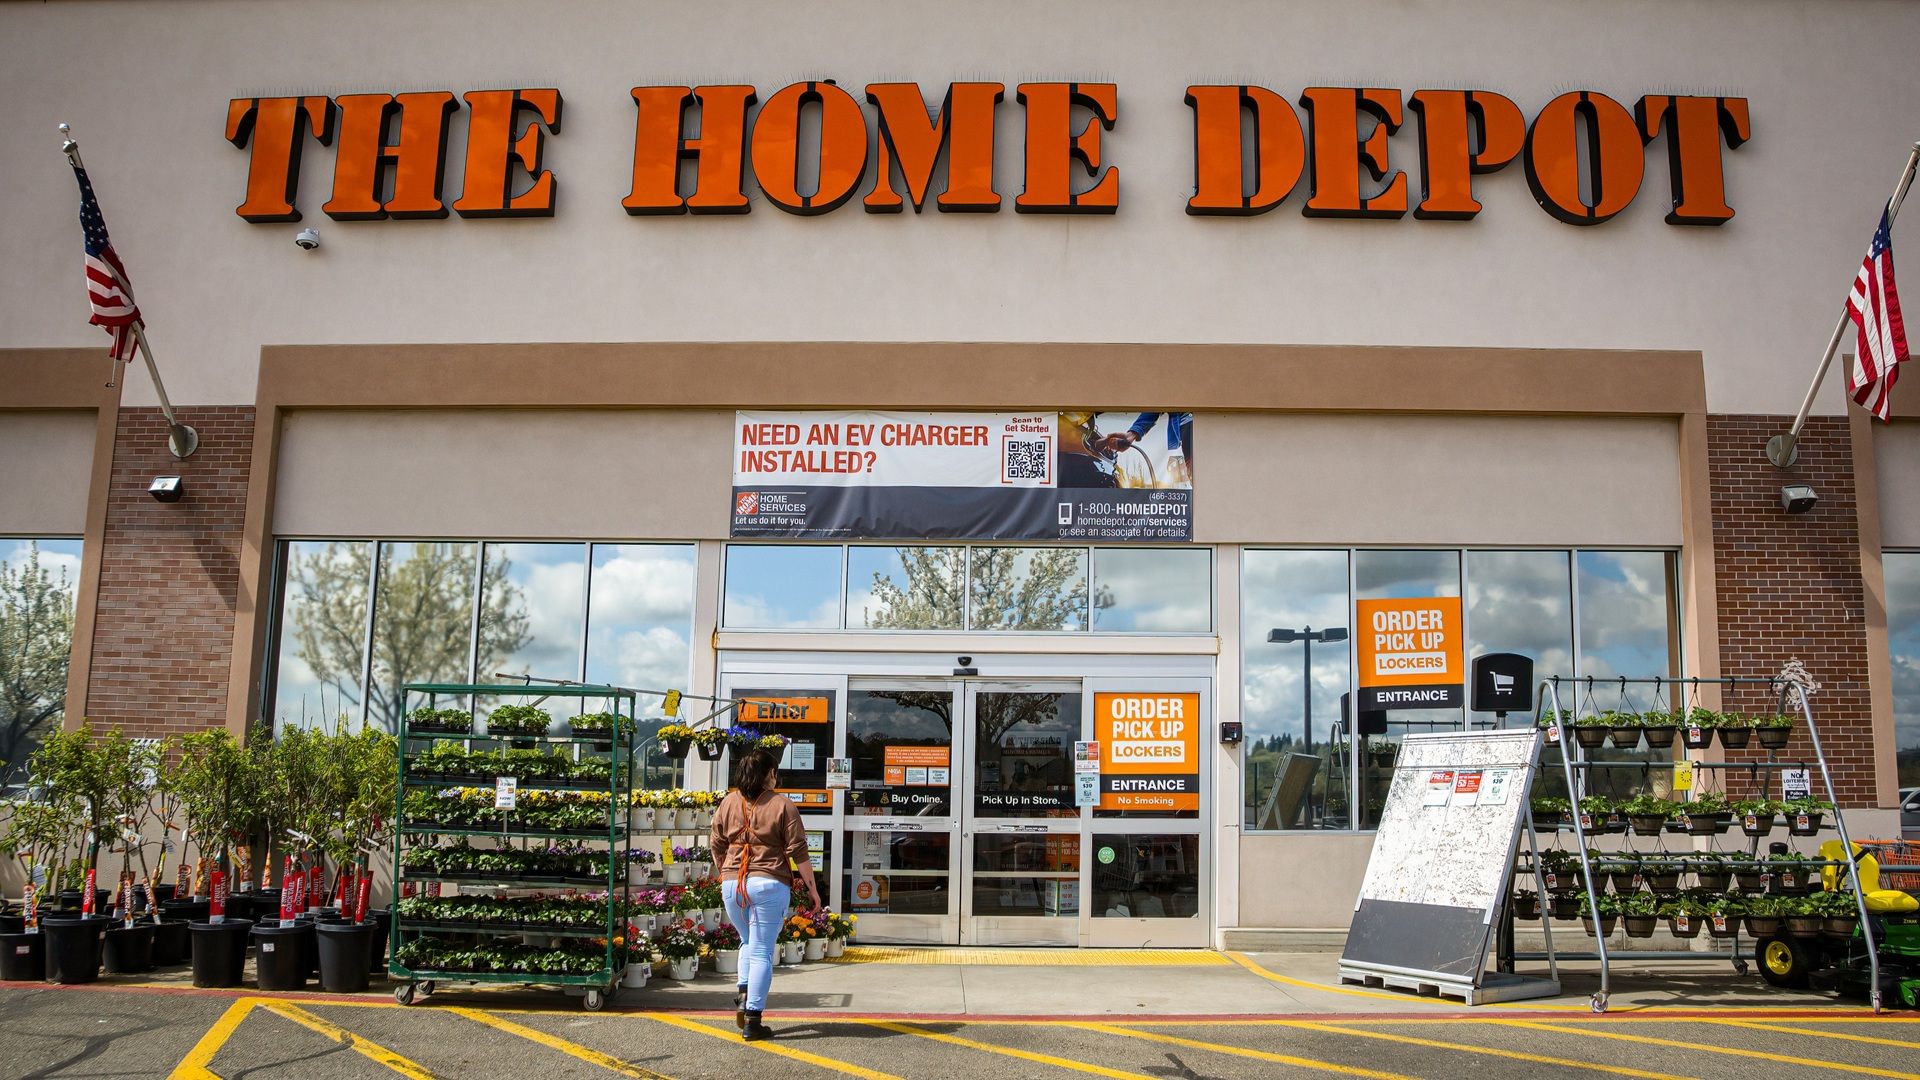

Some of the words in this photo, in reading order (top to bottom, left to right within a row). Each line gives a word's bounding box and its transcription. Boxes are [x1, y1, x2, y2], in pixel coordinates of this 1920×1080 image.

[225, 88, 563, 223] THE
[621, 81, 1120, 216] HOME
[1183, 85, 1751, 226] DEPOT
[1005, 424, 1018, 432] Get
[1020, 424, 1049, 433] Started
[742, 424, 801, 446] NEED
[806, 424, 839, 446] AN
[846, 424, 875, 446] EV
[880, 424, 989, 447] CHARGER
[741, 450, 877, 473] INSTALLED?
[760, 495, 787, 503] HOME
[1149, 492, 1187, 501] (466-3337)
[760, 503, 806, 512] SERVICES
[1078, 502, 1188, 515] 1-800-HOMEDEPOT
[735, 516, 747, 525] Let
[748, 517, 758, 525] us
[759, 516, 768, 524] do
[770, 516, 776, 524] it
[777, 516, 788, 525] for
[790, 518, 806, 526] you.
[1077, 516, 1187, 527] homedepot.com/services
[1060, 528, 1068, 536] or
[1070, 528, 1085, 536] see
[1088, 528, 1099, 536] an
[1101, 528, 1141, 537] associate
[1143, 527, 1154, 537] for
[1157, 527, 1188, 537] details.
[1373, 609, 1443, 632] ORDER
[1375, 633, 1416, 651] PICK
[1421, 632, 1444, 649] UP
[1379, 656, 1444, 670] LOCKERS
[1377, 690, 1448, 703] ENTRANCE
[757, 701, 809, 720] Enter
[1111, 698, 1184, 719] ORDER
[1112, 720, 1154, 739] PICK
[1160, 720, 1184, 739] UP
[1115, 746, 1182, 757] LOCKERS
[1111, 779, 1185, 791] ENTRANCE
[891, 794, 909, 804] Buy
[911, 794, 943, 803] Online.
[982, 796, 1003, 805] Pick
[1005, 796, 1015, 806] Up
[1021, 796, 1030, 805] In
[1032, 796, 1060, 805] Store.
[1118, 796, 1132, 805] No
[1134, 796, 1174, 806] Smoking
[286, 880, 295, 912] COCKTAIL
